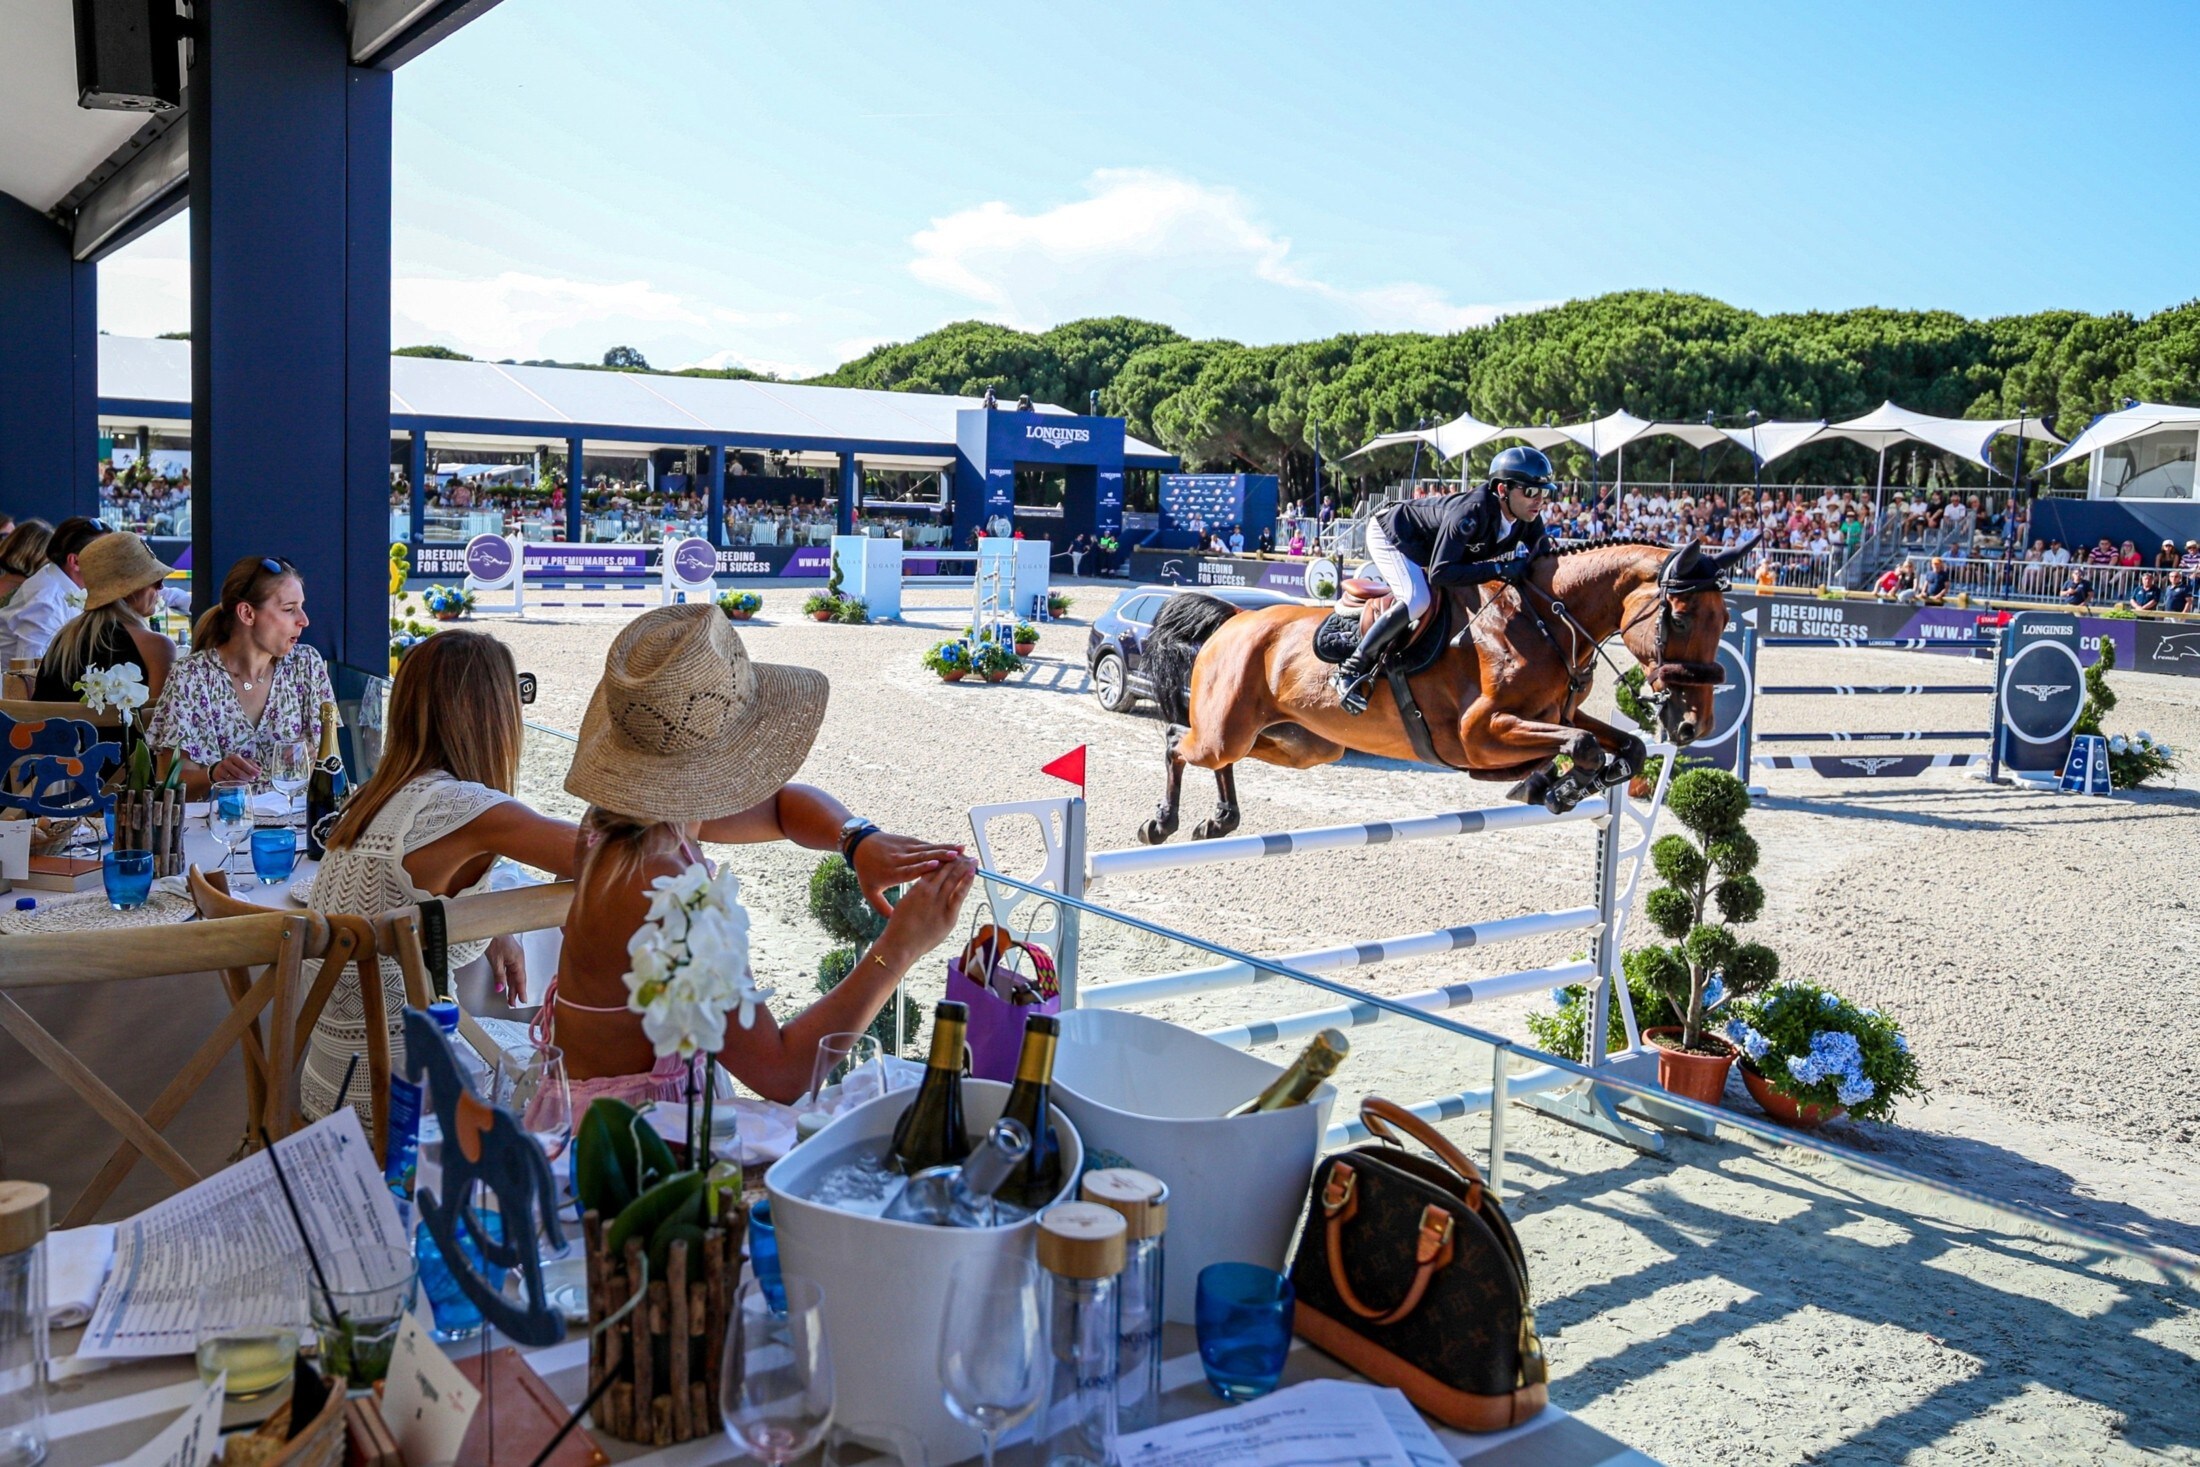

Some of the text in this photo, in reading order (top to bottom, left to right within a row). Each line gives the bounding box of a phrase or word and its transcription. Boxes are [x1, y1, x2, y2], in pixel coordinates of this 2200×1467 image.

[1026, 426, 1090, 442] LONGINES
[417, 549, 465, 560] BREEDIN
[716, 551, 756, 561] REEDING
[417, 560, 468, 573] FOR SUCC
[524, 556, 637, 566] WWW.PREMIUMARES.COM
[715, 561, 770, 573] OR SUCCESS
[798, 557, 831, 568] WWW.PR
[1198, 562, 1234, 575] BREEDING
[1198, 573, 1246, 586] FOR SUCCESS
[1269, 574, 1305, 587] WWW.PRE
[1771, 603, 1843, 622] BREEDING
[1770, 618, 1869, 640] FOR SUCCESS
[1920, 624, 1973, 641] WWW.P
[2021, 624, 2073, 636] LONGINES
[2072, 757, 2084, 769] C
[2095, 760, 2104, 771] C
